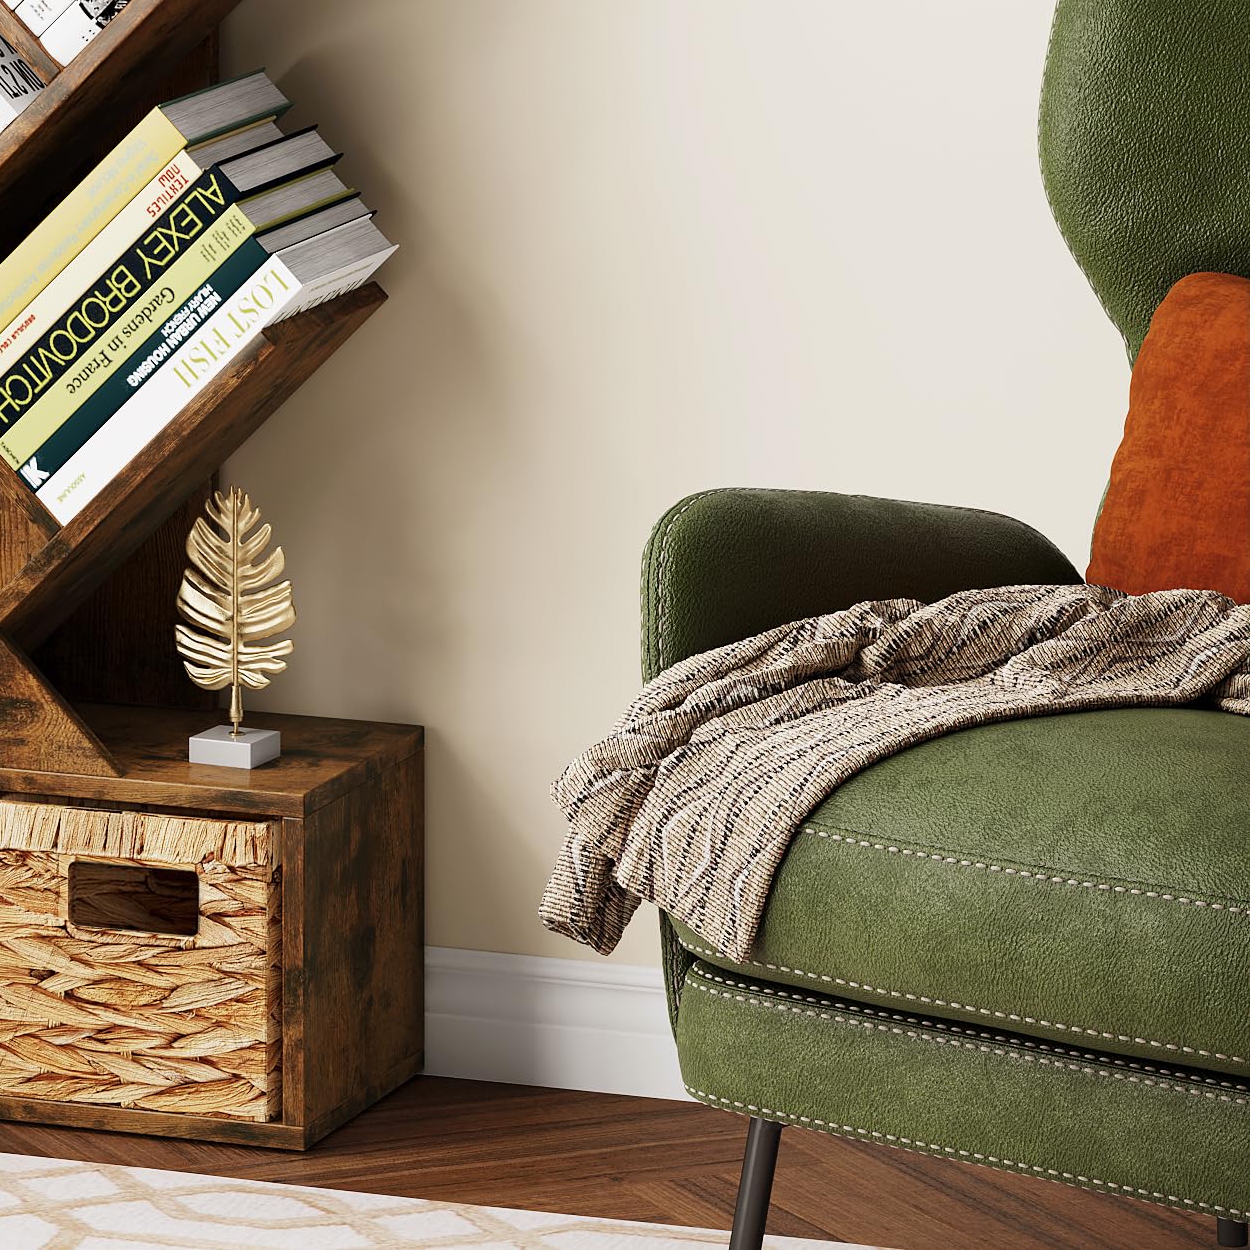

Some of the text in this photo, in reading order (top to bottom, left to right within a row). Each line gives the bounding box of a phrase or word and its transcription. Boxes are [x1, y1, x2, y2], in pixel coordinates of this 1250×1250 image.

[132, 172, 228, 281] ALEXEY
[146, 171, 189, 218] TEXTILES
[126, 290, 222, 388] NEW URBAN HOUSING
[160, 283, 213, 338] HILARY FRENCH
[224, 268, 289, 339] LOST
[65, 285, 176, 397] Gardens in France
[172, 326, 231, 389] FISH
